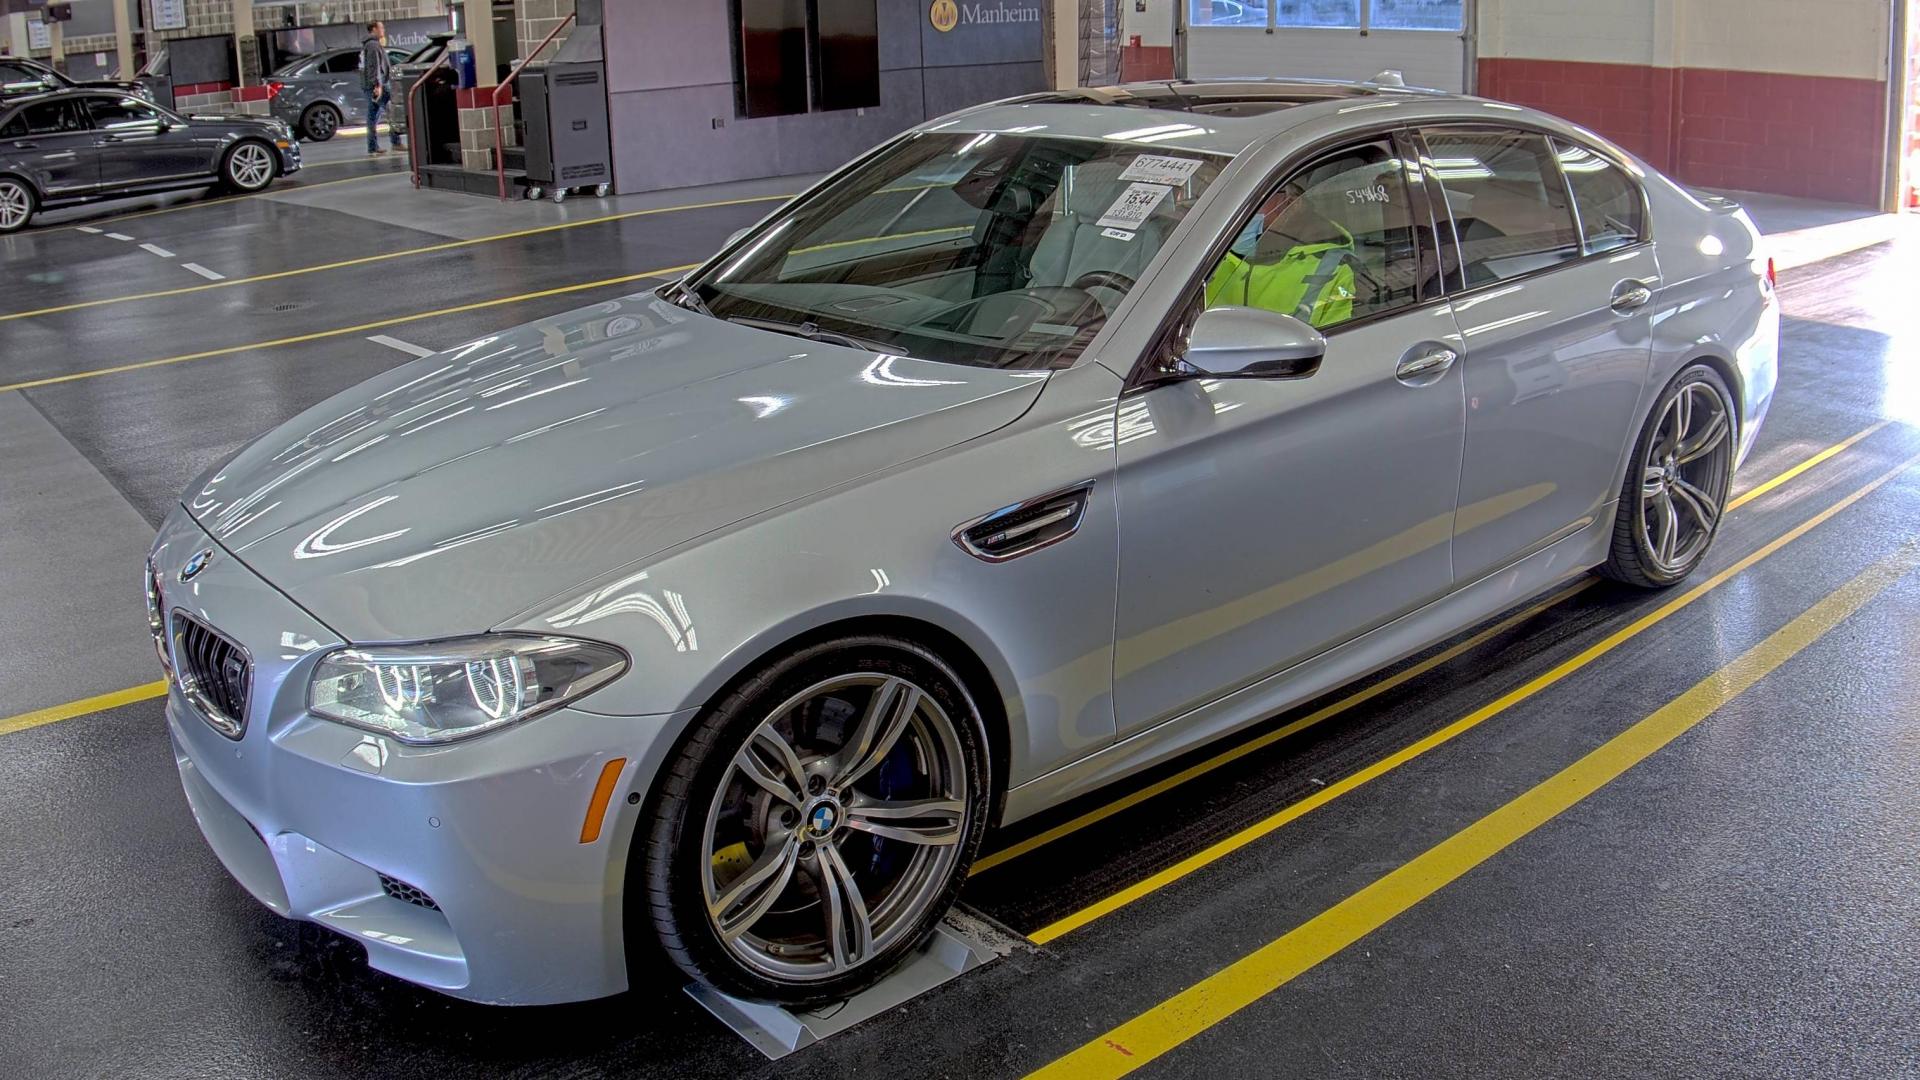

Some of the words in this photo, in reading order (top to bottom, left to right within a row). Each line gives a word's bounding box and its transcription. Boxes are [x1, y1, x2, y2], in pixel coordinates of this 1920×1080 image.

[962, 2, 1039, 24] Manheim
[388, 31, 428, 46] Manhe
[1135, 158, 1194, 172] 6774441
[1125, 193, 1155, 206] 15:44
